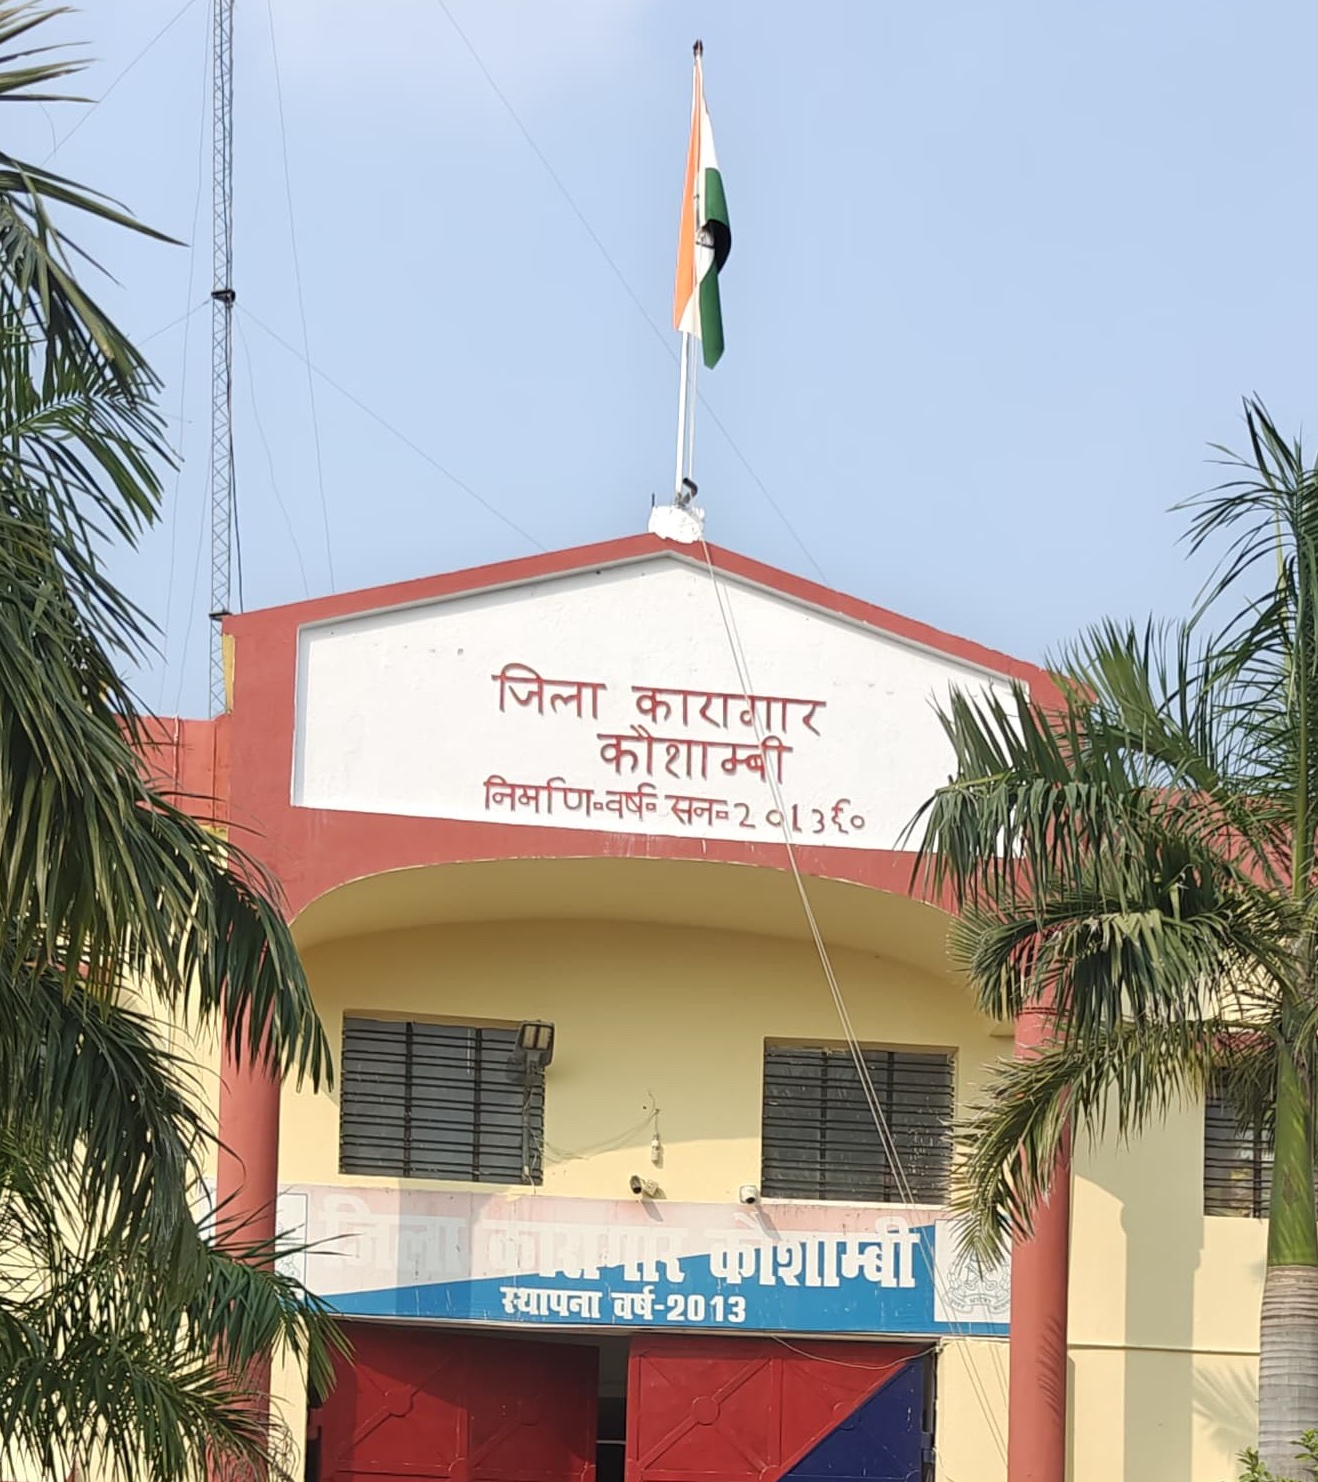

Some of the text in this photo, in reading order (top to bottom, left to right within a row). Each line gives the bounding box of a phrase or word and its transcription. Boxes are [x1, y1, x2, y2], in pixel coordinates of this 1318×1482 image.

[491, 662, 826, 737] जिला कारागार
[597, 724, 793, 784] कौशाम्बी
[705, 1211, 921, 1289] कौशाम्बी
[500, 1286, 603, 1319] स्थापना
